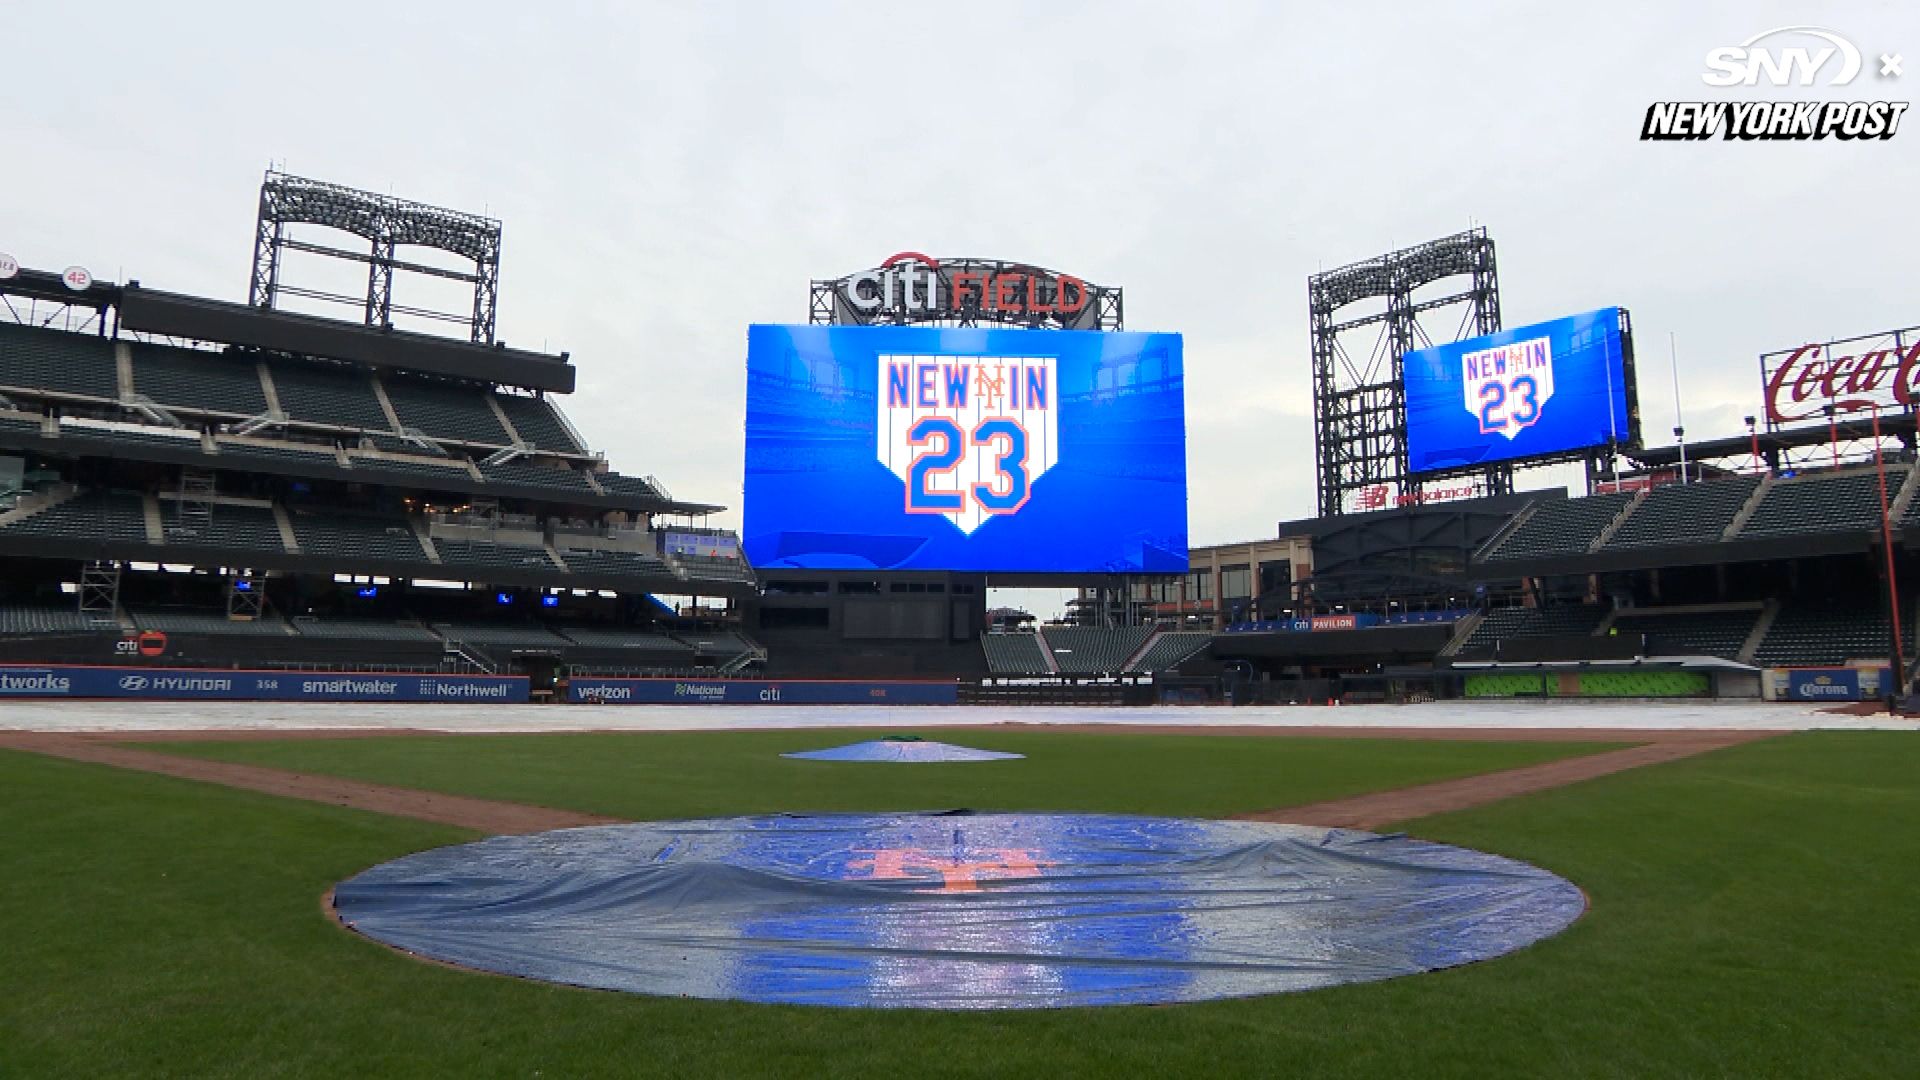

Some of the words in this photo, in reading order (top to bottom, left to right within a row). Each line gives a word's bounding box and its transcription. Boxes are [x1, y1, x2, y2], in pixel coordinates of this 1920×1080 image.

[67, 271, 87, 284] 42
[847, 261, 937, 310] citi
[951, 271, 1087, 313] FIELD
[1466, 349, 1507, 381] NEW
[1525, 341, 1546, 369] IN
[887, 362, 971, 409] NEW
[1009, 364, 1048, 411] IN
[1478, 373, 1543, 435] 23
[904, 415, 1031, 515] 23
[1313, 619, 1353, 629] PAVILION
[0, 673, 70, 689] tworks
[153, 678, 231, 691] HYUNDAI
[257, 680, 278, 689] 358
[302, 680, 397, 694] smartwater
[437, 683, 507, 697] Northwell
[577, 684, 631, 699] verizon
[686, 683, 726, 695] National
[759, 687, 782, 701] citi
[1800, 683, 1849, 697] Corona
